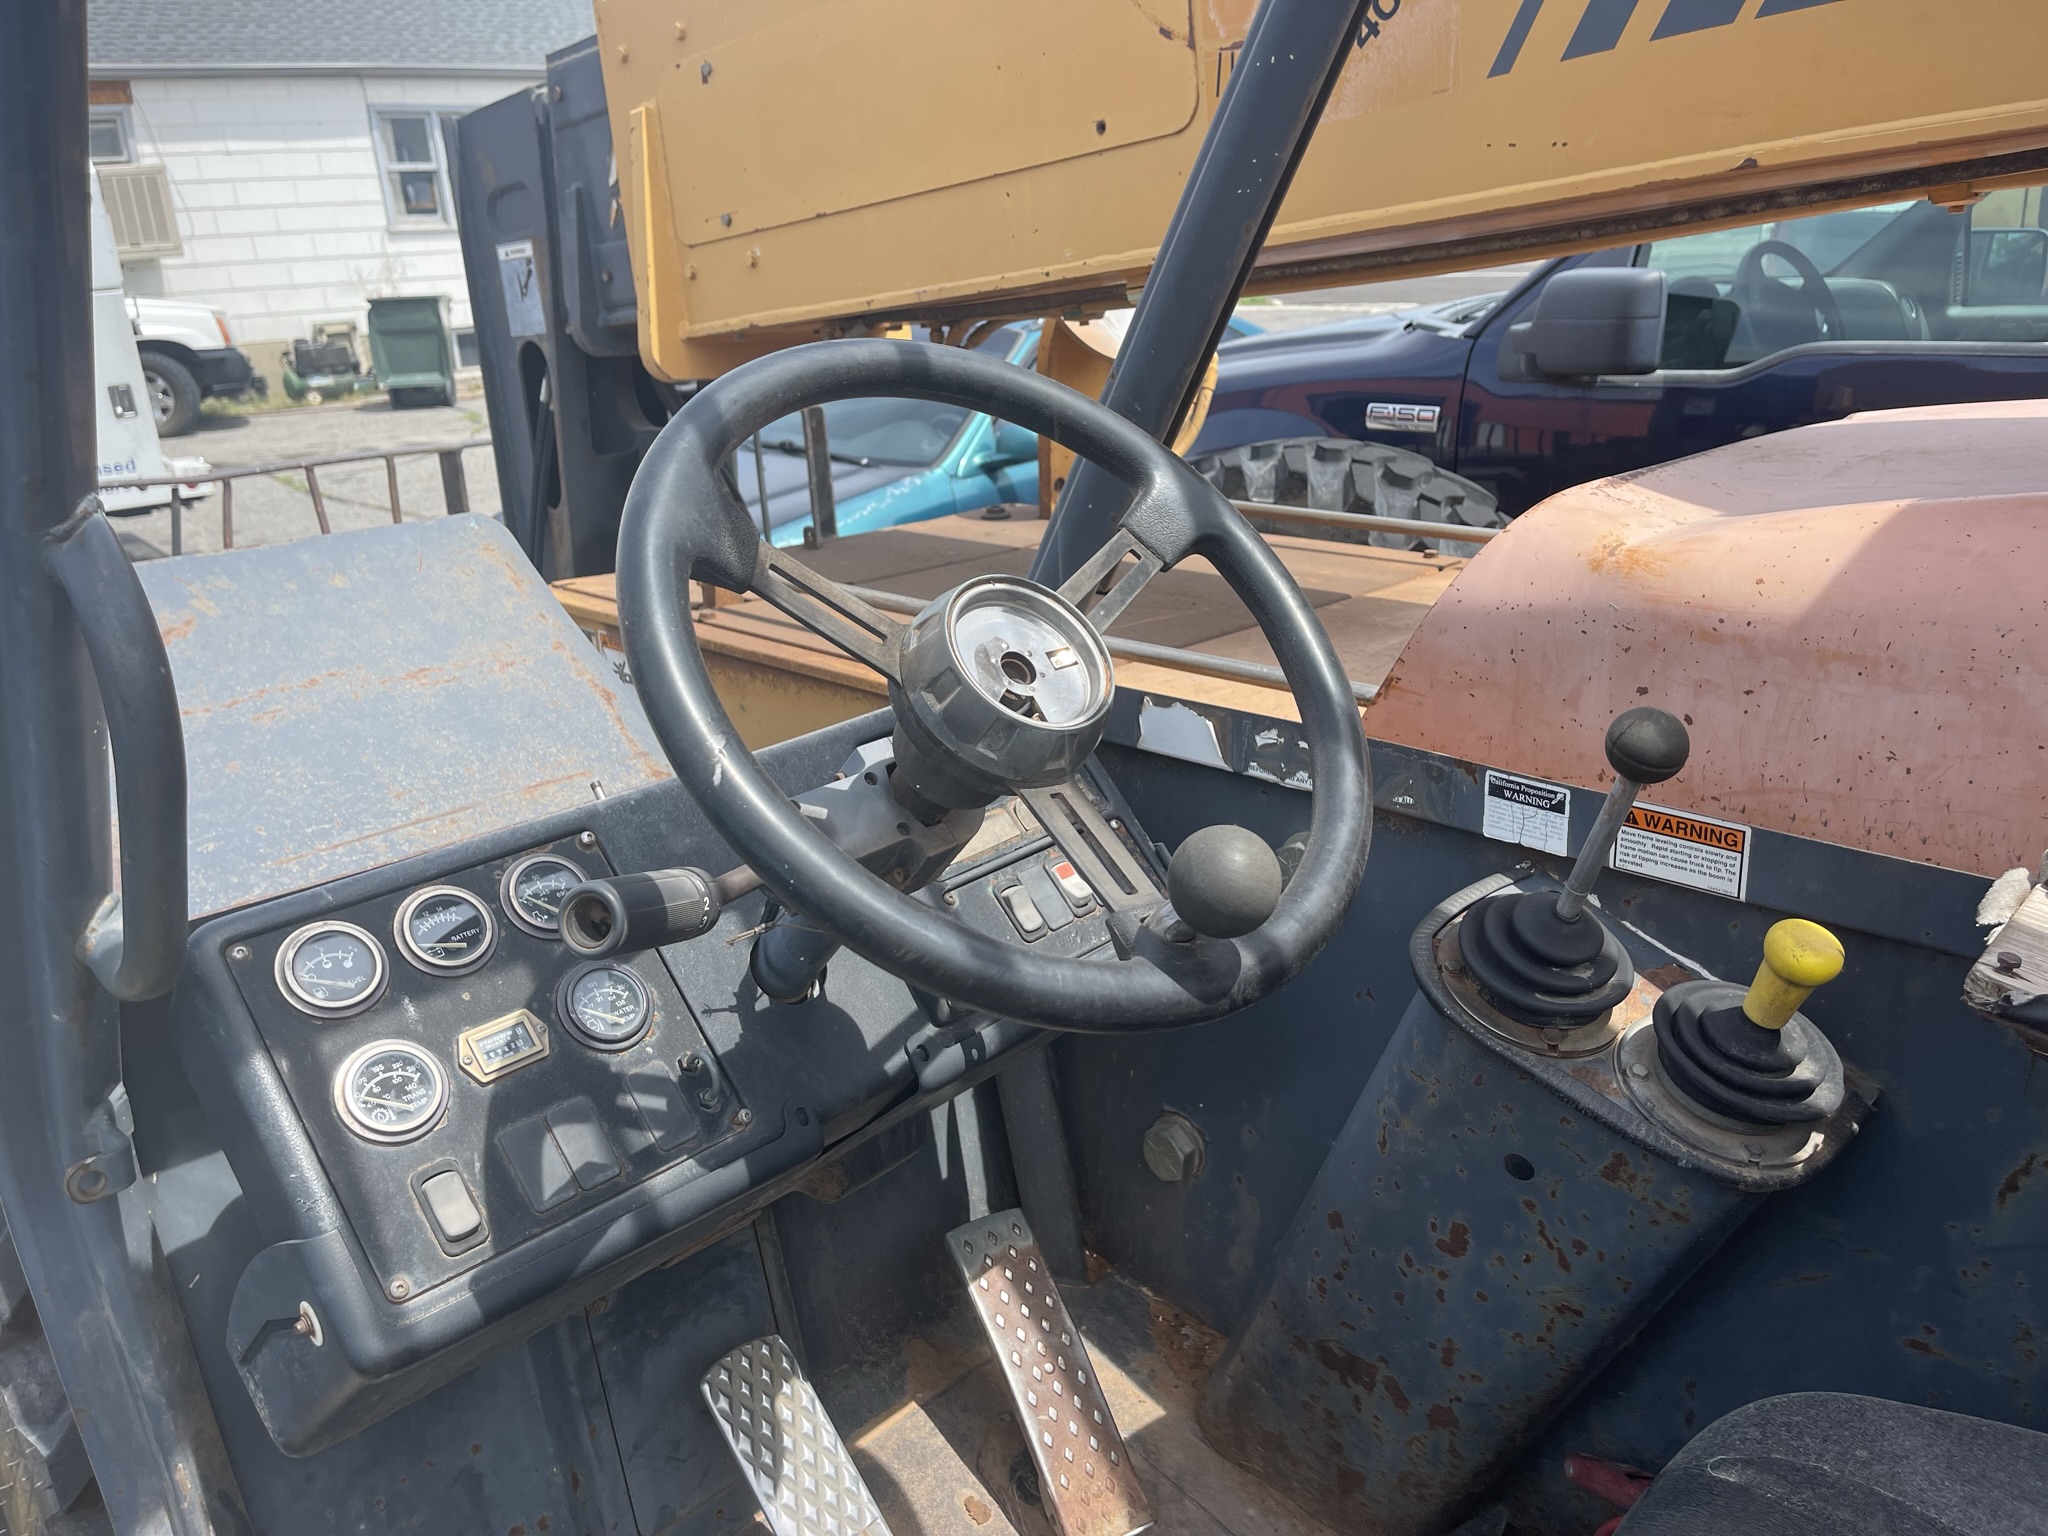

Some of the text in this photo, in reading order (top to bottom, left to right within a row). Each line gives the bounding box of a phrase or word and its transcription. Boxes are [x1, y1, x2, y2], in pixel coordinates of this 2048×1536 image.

[1489, 776, 1520, 791] California
[1521, 785, 1556, 800] Proposition
[1503, 789, 1551, 809] WARNING
[1644, 812, 1739, 849] WARNING
[1621, 829, 1738, 862] Move frame leveling controls slowly and
[1651, 843, 1669, 853] Rapid
[1670, 848, 1692, 859] starting
[1701, 856, 1728, 868] stopping
[1620, 843, 1637, 852] frame
[1638, 848, 1658, 857] motion
[1671, 856, 1689, 865] cause
[1689, 860, 1705, 869] truck
[1725, 868, 1737, 876] The
[1638, 855, 1659, 866] tipping
[1660, 860, 1688, 872] increases
[1698, 869, 1708, 877] the
[1708, 872, 1726, 881] boom
[422, 910, 430, 918] 12
[450, 927, 480, 942] BATTERY
[371, 1063, 385, 1073] 195
[391, 1060, 404, 1069] 220
[402, 1087, 427, 1103] TRANS
[404, 1081, 418, 1092] 140
